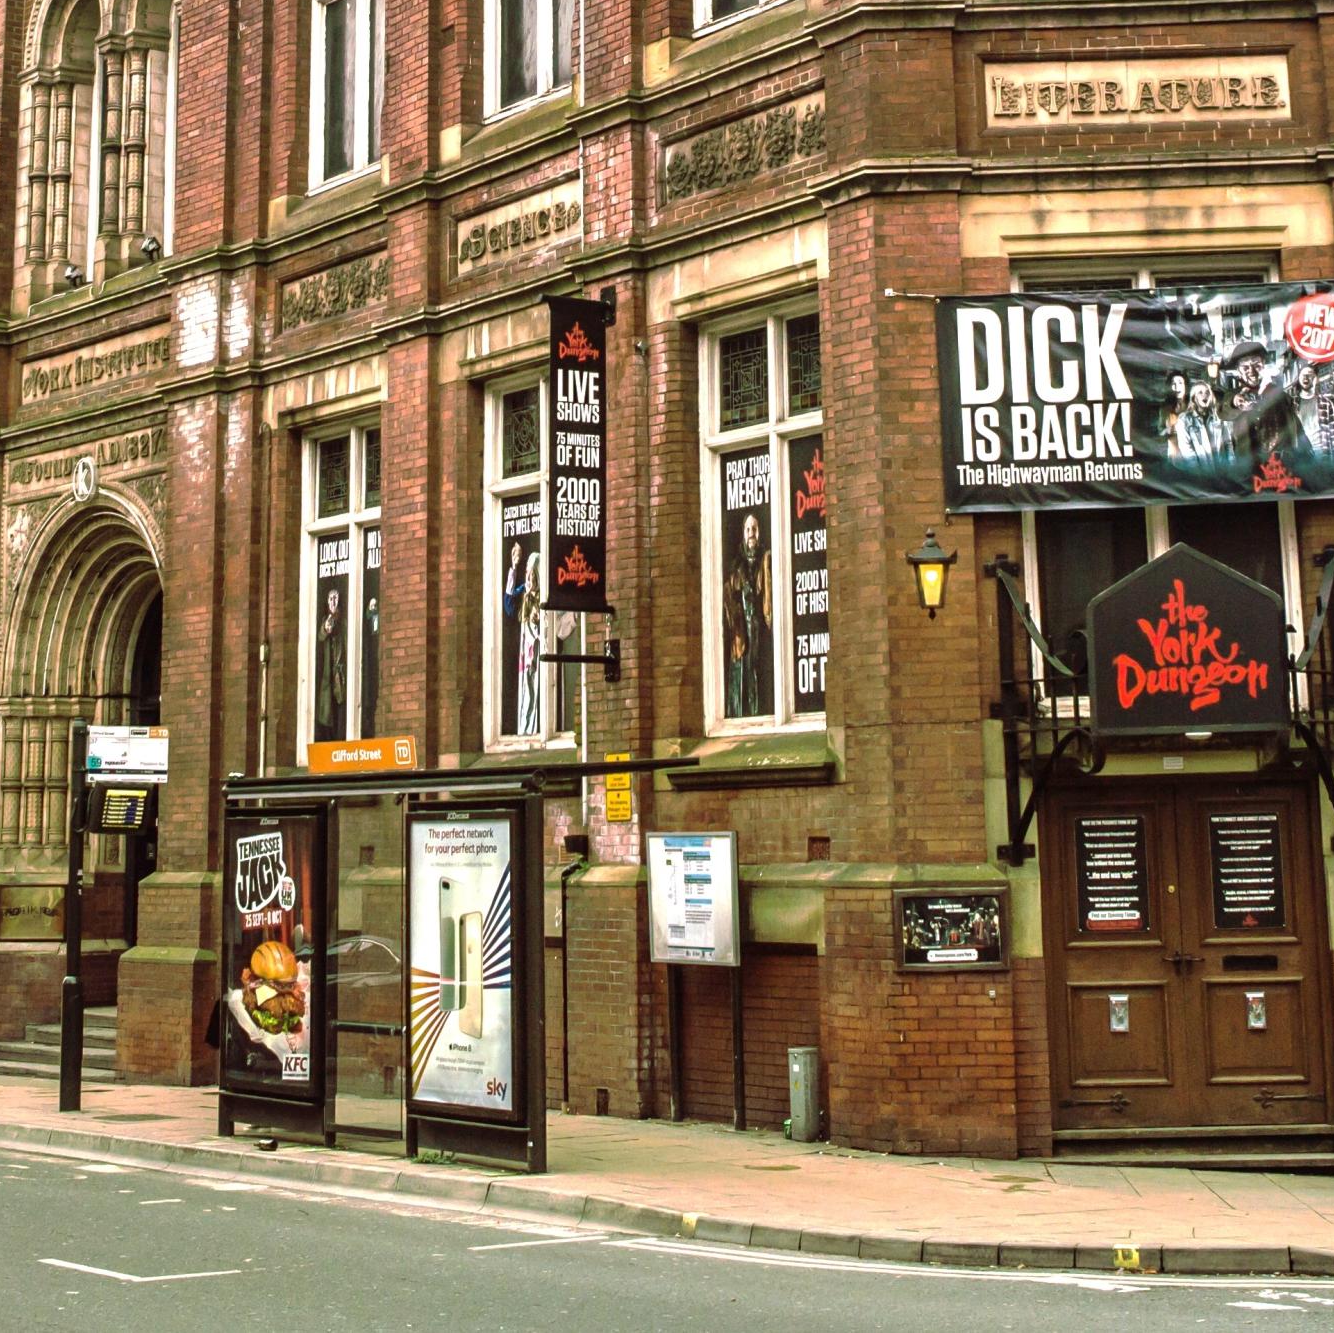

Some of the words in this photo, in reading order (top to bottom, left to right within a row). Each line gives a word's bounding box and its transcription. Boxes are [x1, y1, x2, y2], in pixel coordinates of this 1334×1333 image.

[956, 303, 1134, 405] DICK
[557, 368, 599, 404] LIVE
[557, 402, 599, 424] SHOWS
[556, 432, 566, 445] 75
[567, 433, 600, 447] MINUTES
[962, 406, 1001, 462] IS
[1011, 402, 1133, 461] BACK!
[557, 445, 572, 466] OF
[575, 446, 600, 468] FUN
[26, 452, 91, 484] FOUND
[726, 459, 747, 480] PRAY
[956, 465, 984, 486] The
[987, 463, 1082, 487] Highwayman
[1084, 461, 1143, 482] Returns
[557, 476, 600, 504] 2000
[726, 473, 771, 510] MERCY
[557, 503, 587, 519] YEARS
[588, 505, 600, 520] OF
[516, 518, 530, 535] WELL
[557, 519, 600, 537] HISTORY
[320, 540, 337, 563] LOOK
[794, 532, 813, 554] LIVE
[796, 571, 819, 592] 2000
[797, 594, 810, 616] OF
[1161, 579, 1209, 627] the
[797, 635, 808, 656] 75
[1137, 618, 1240, 666] York
[799, 660, 816, 694] OF
[1113, 654, 1268, 711] Dungeon
[331, 748, 358, 762] Clifford
[359, 748, 382, 761] Street
[398, 746, 408, 757] TD
[429, 829, 440, 839] The
[441, 828, 465, 840] perfect
[467, 828, 493, 838] network
[239, 837, 280, 859] TENNESSEE
[425, 843, 433, 853] for
[435, 846, 450, 856] your
[451, 843, 475, 855] perfect
[476, 843, 497, 855] phone
[238, 852, 284, 910] JACK
[246, 914, 252, 927] 25
[272, 911, 283, 924] OCT
[284, 1057, 308, 1072] KFC
[487, 1077, 507, 1101] sky
